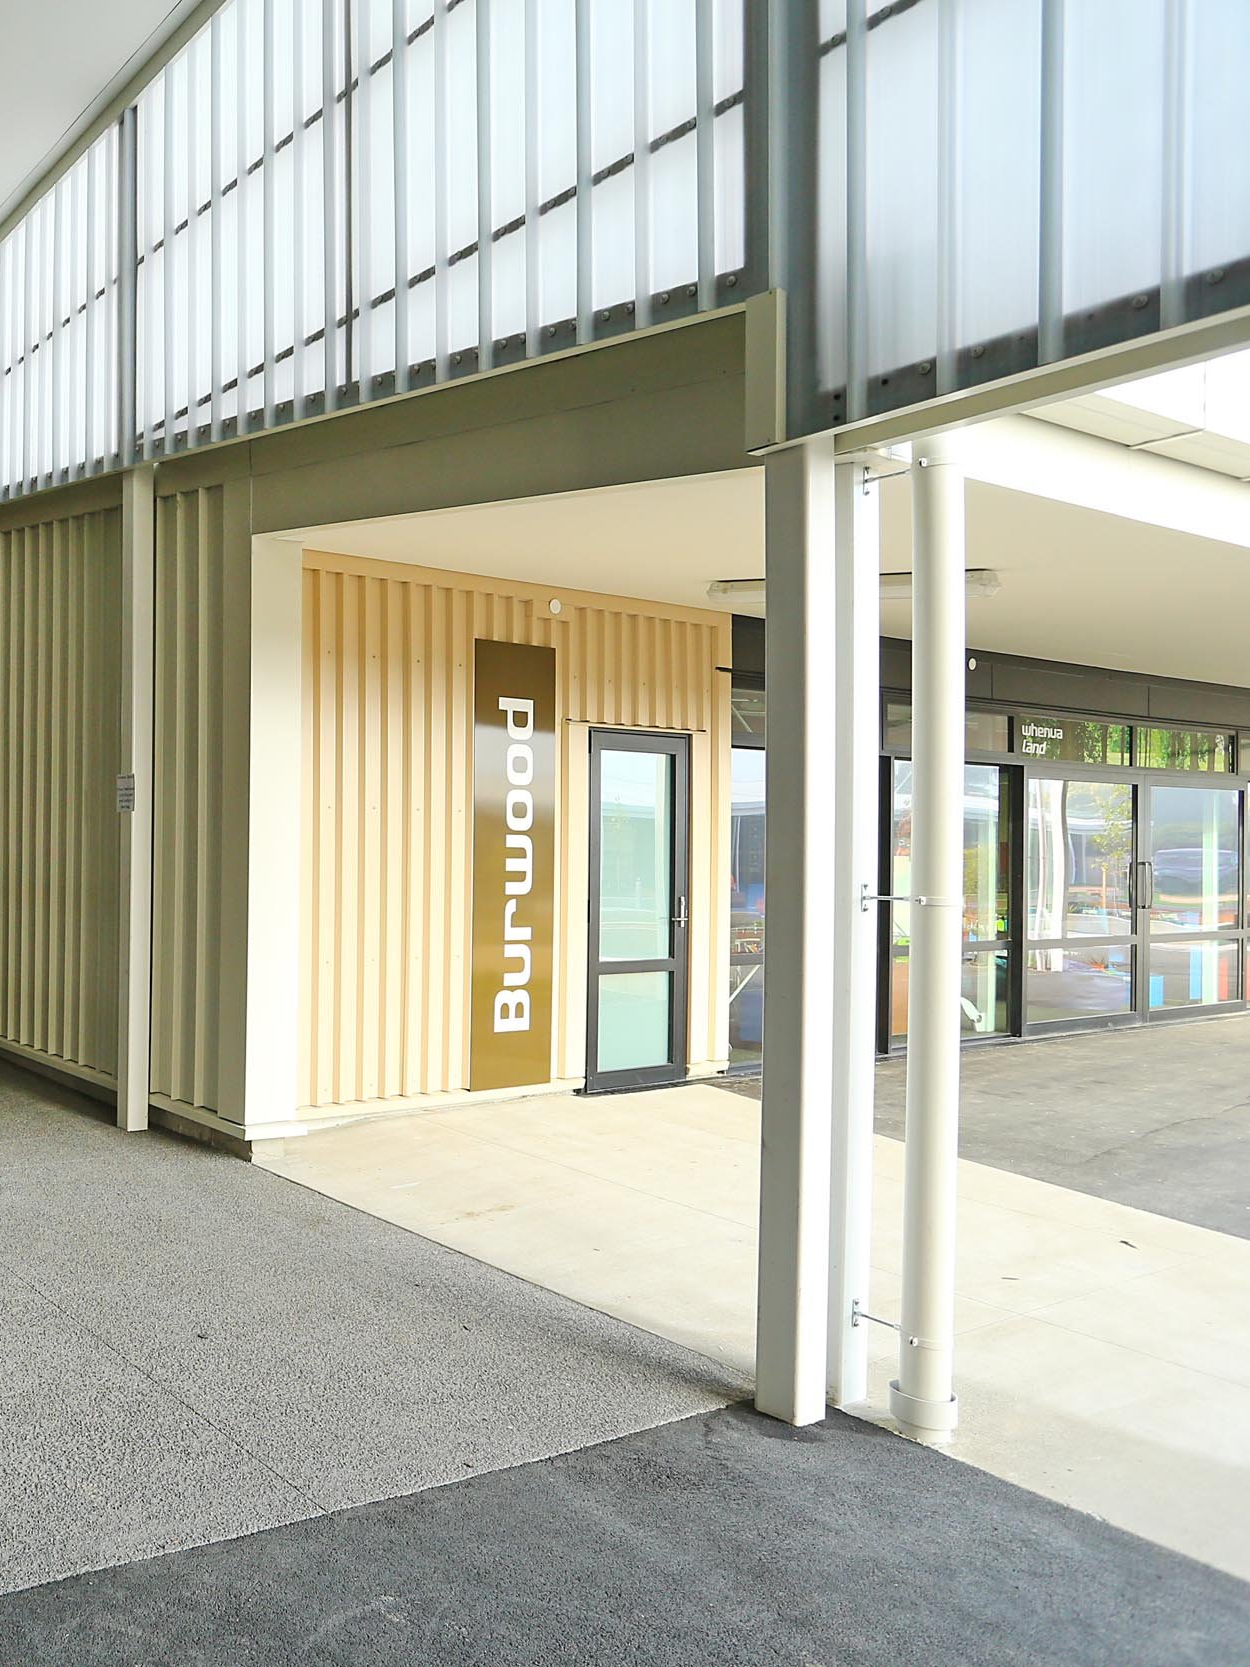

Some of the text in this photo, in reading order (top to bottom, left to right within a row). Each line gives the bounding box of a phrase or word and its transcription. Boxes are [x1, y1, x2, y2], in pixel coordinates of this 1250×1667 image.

[1021, 723, 1063, 739] whenua
[1022, 740, 1047, 755] land
[493, 696, 534, 1034] Burwood
